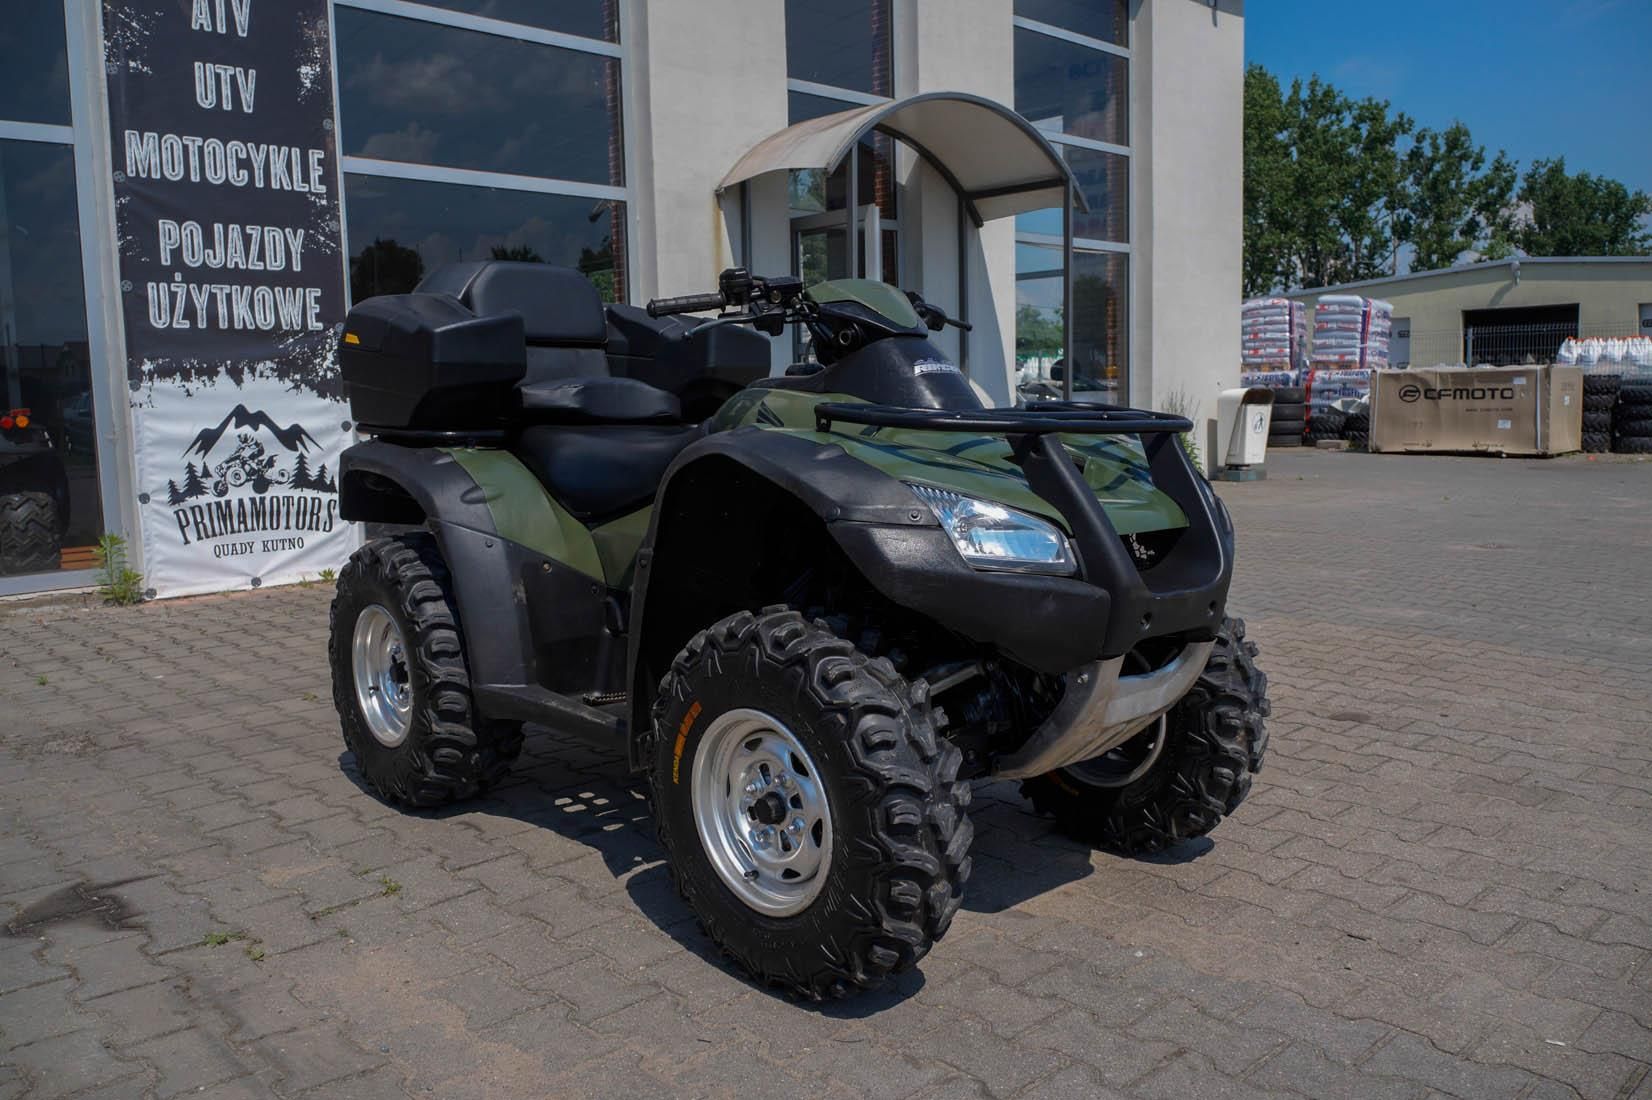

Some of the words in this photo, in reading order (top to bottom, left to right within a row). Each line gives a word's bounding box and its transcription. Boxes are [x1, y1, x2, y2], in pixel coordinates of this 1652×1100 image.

[194, 61, 256, 113] UTV
[124, 130, 327, 193] MOTOCYKLE
[158, 219, 304, 271] POJAZDY
[147, 272, 324, 331] UŻYTKOWE
[1424, 387, 1514, 400] CFMOTO
[173, 495, 337, 546] PRIMAMOTORS
[213, 542, 255, 558] QUADY
[262, 536, 305, 553] KUTNO
